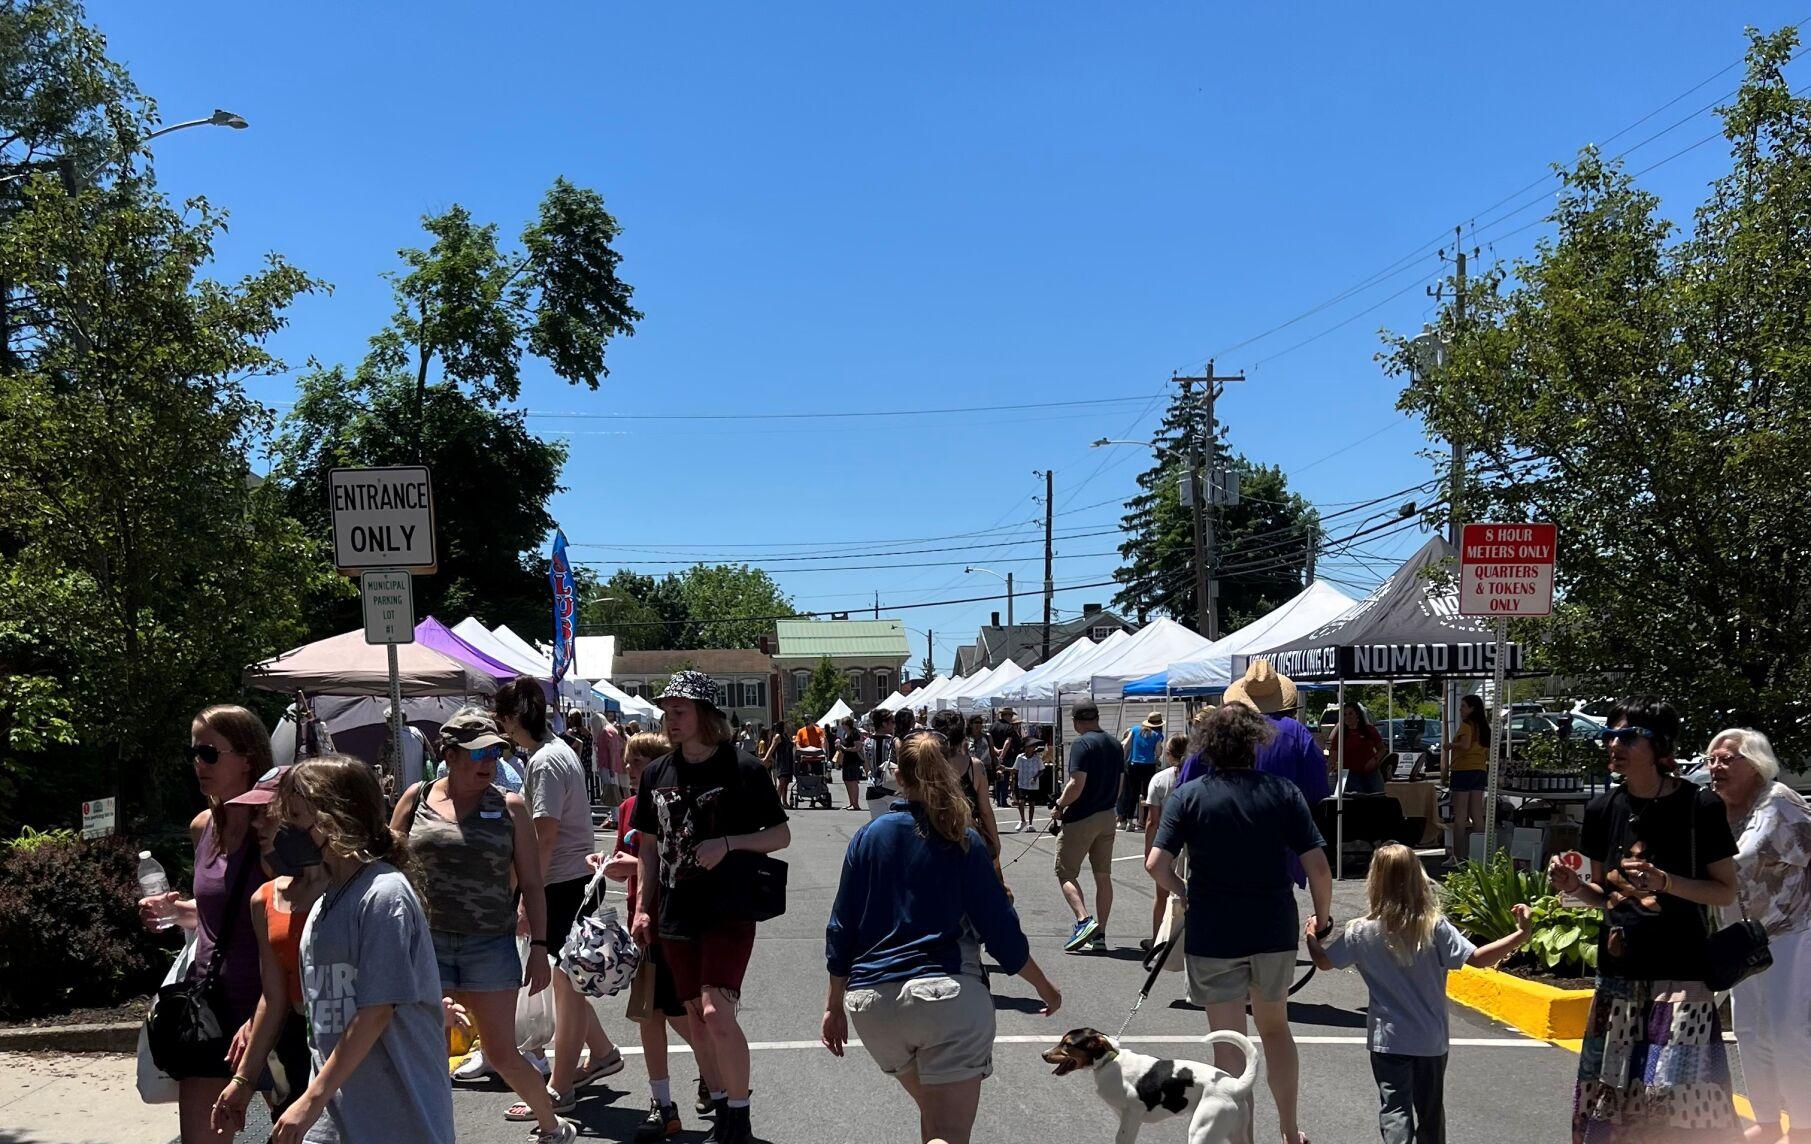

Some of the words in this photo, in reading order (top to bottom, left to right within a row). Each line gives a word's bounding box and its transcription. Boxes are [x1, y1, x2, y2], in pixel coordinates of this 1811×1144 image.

[334, 482, 428, 511] ENTRANCE
[350, 525, 416, 552] ONLY
[1485, 528, 1494, 542] 8
[1498, 528, 1533, 542] HOUR
[1466, 545, 1515, 559] METERS
[1518, 545, 1550, 558] ONLY
[1474, 565, 1539, 580] QUARTERS
[367, 580, 406, 591] MUNICIPAL
[1475, 582, 1485, 595] &
[1488, 582, 1536, 595] TOKENS
[373, 595, 403, 606] PARKING
[1489, 598, 1520, 611] ONLY
[383, 609, 395, 620] LOT
[385, 625, 394, 634] #1
[1277, 648, 1322, 677] DISTILLING
[1323, 646, 1336, 675] CO
[1353, 643, 1449, 673] NOMAD
